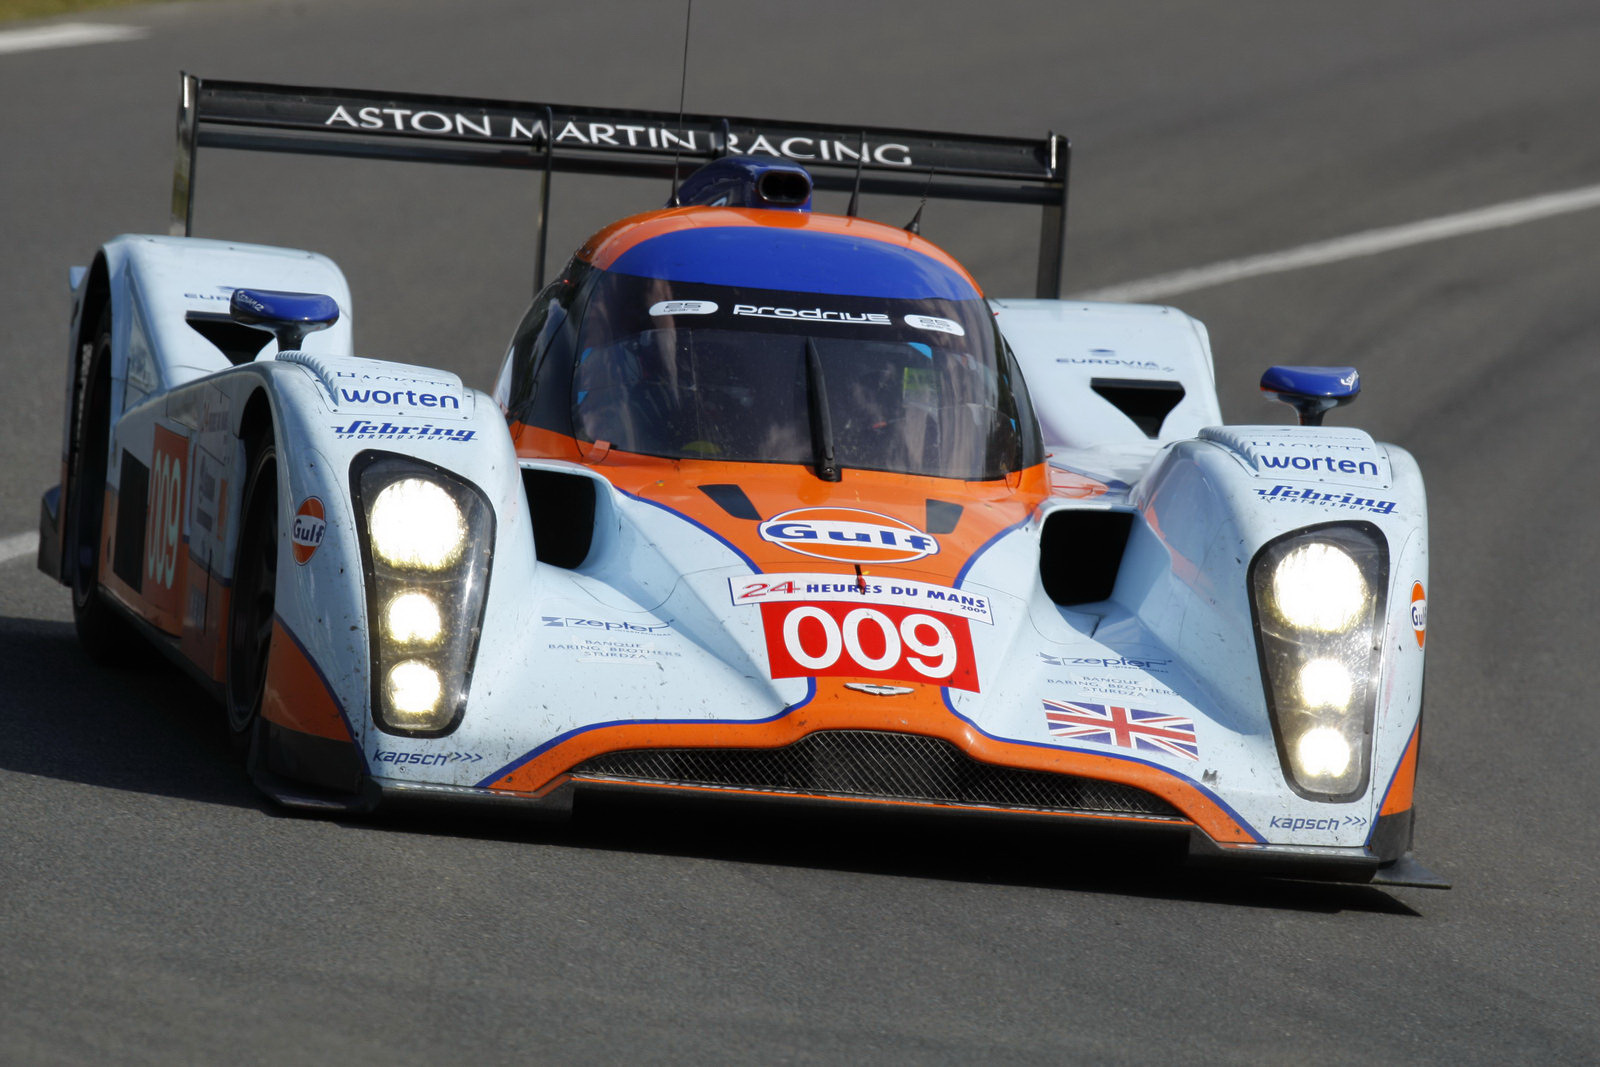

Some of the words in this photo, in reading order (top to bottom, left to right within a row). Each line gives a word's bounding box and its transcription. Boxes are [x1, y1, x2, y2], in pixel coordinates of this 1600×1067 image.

[324, 104, 492, 137] ASTON
[510, 117, 697, 150] MARTIN
[709, 132, 912, 166] RACING
[1056, 358, 1159, 368] EUROVIA
[340, 388, 460, 409] worten
[330, 420, 478, 442] Sebring
[1260, 455, 1379, 476] worten
[1253, 485, 1399, 515] Sebring
[147, 450, 181, 590] 009
[293, 518, 325, 543] Gulf
[765, 523, 932, 551] Gulf
[737, 581, 801, 599] 24
[806, 583, 883, 595] HEURES
[891, 586, 918, 597] DU
[926, 590, 985, 608] MANS
[960, 604, 987, 615] 2009
[573, 618, 675, 633] zepter
[783, 606, 958, 679] 009
[1070, 656, 1173, 669] zepter
[373, 749, 448, 766] kapsch
[1269, 815, 1340, 832] kapsch
